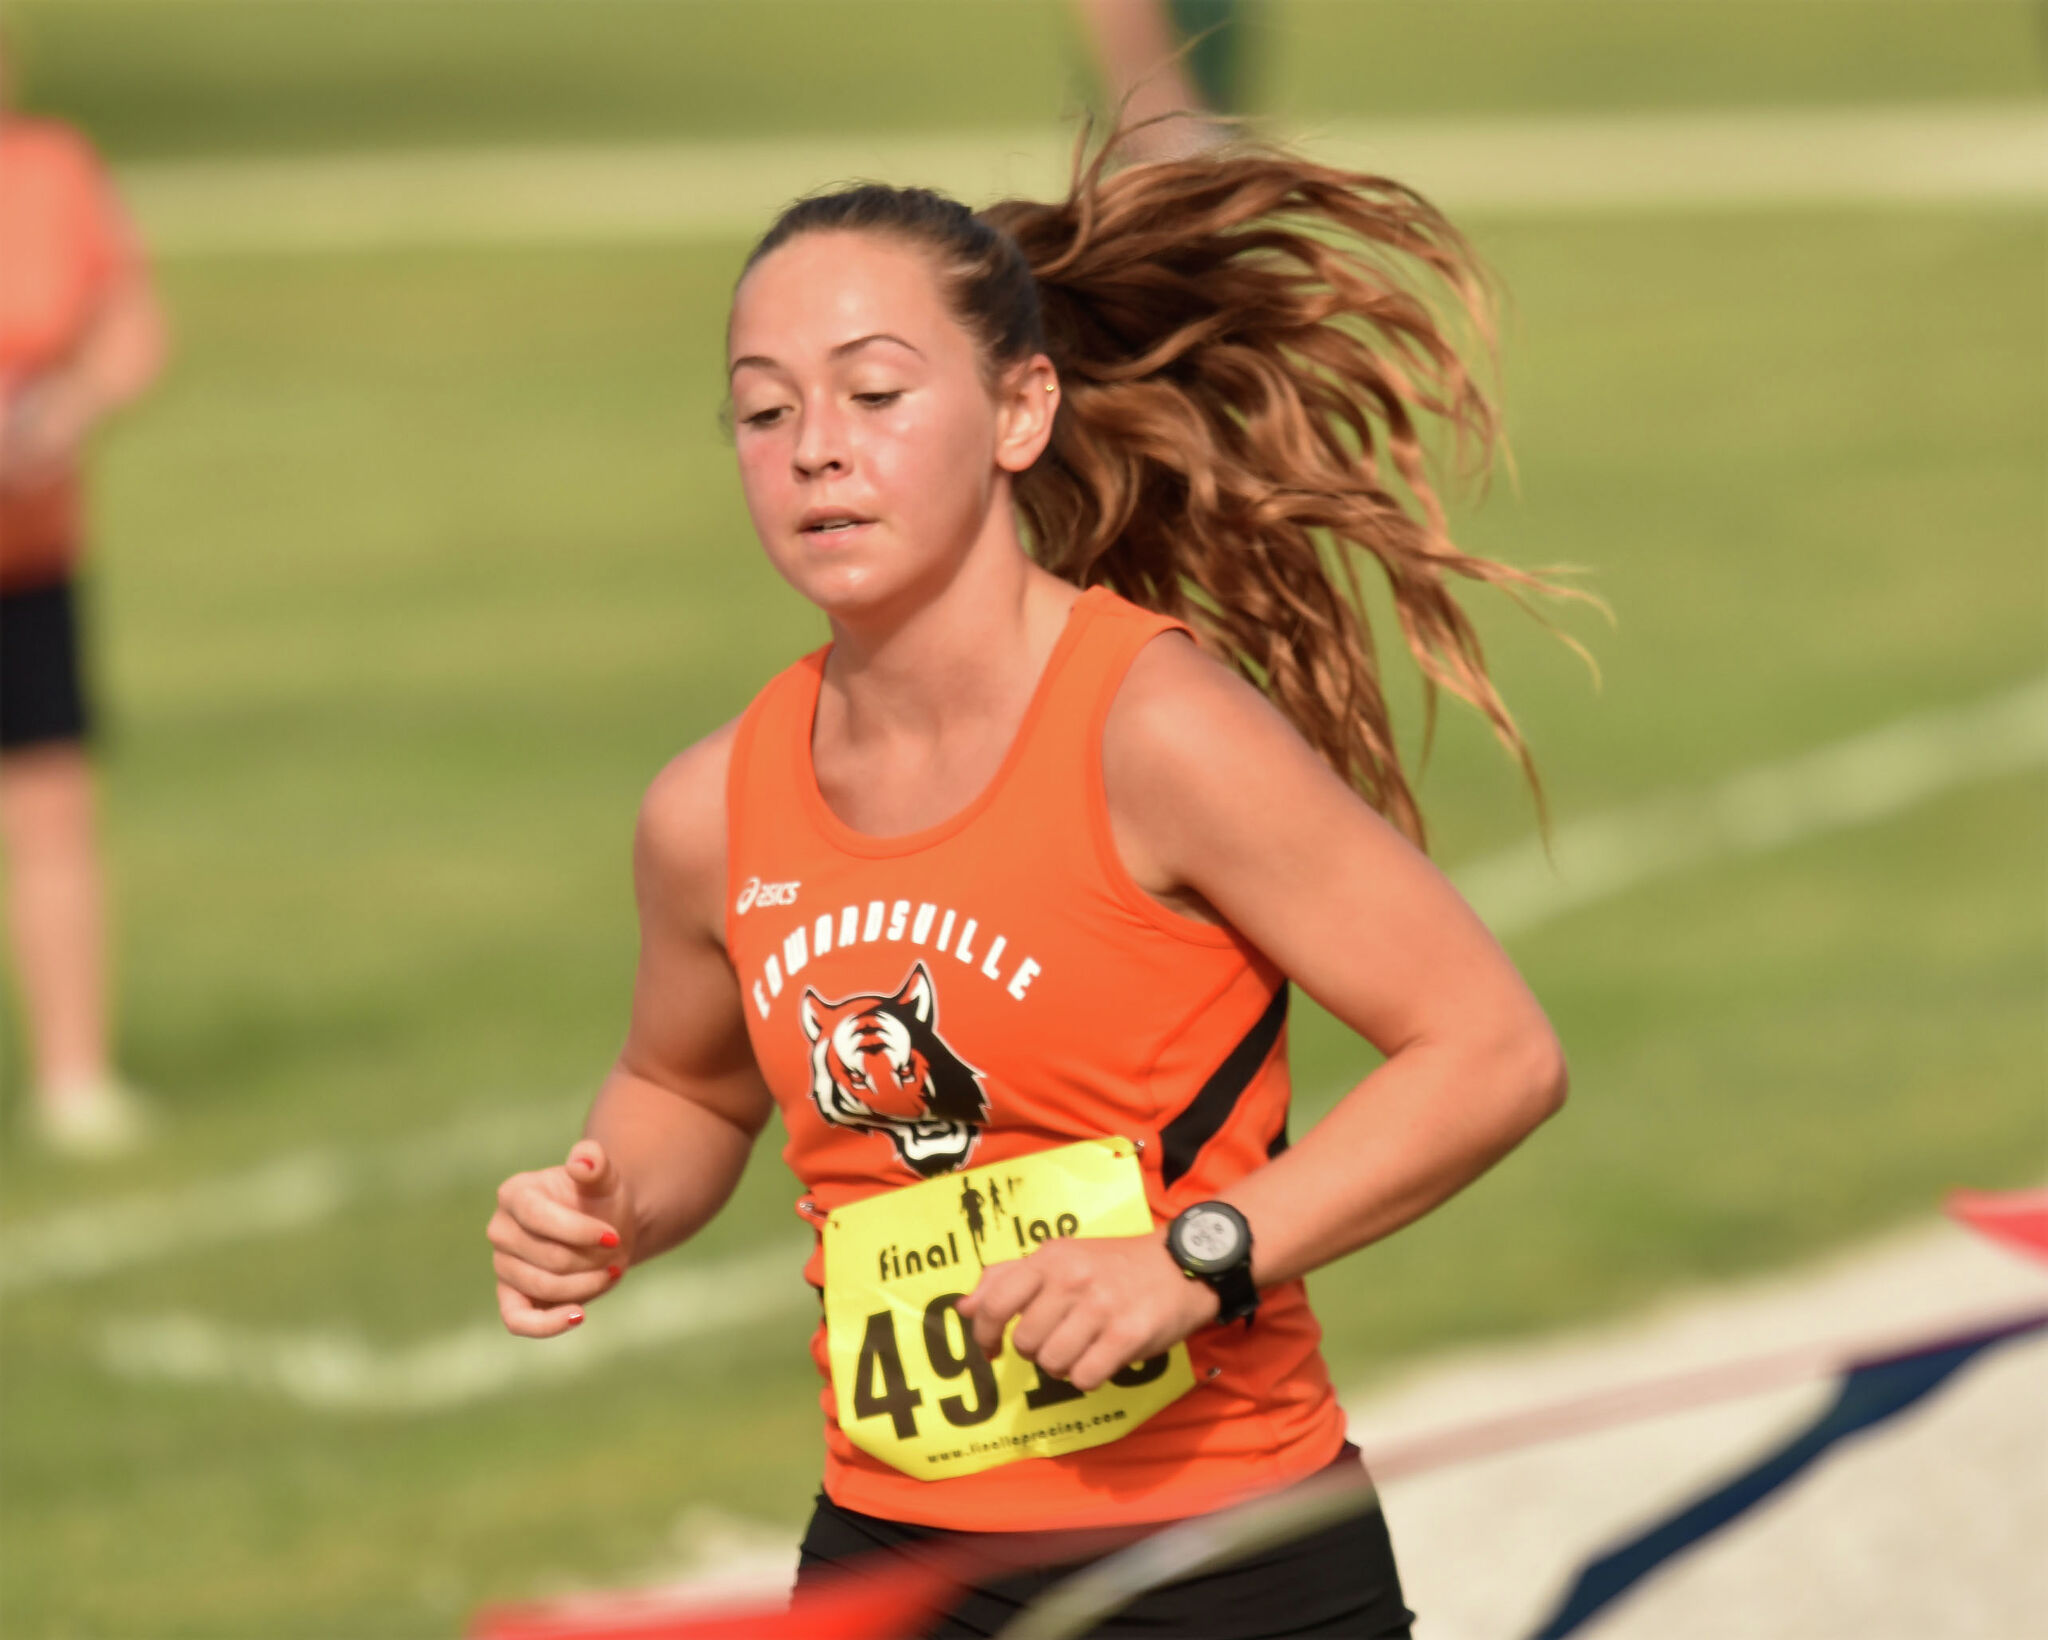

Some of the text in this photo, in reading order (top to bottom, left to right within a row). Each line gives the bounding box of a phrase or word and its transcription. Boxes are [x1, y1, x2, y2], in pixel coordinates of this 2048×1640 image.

[753, 900, 1042, 1020] EDWARDSVILLE
[879, 1213, 1079, 1281] final lap
[853, 1292, 1170, 1441] 49
